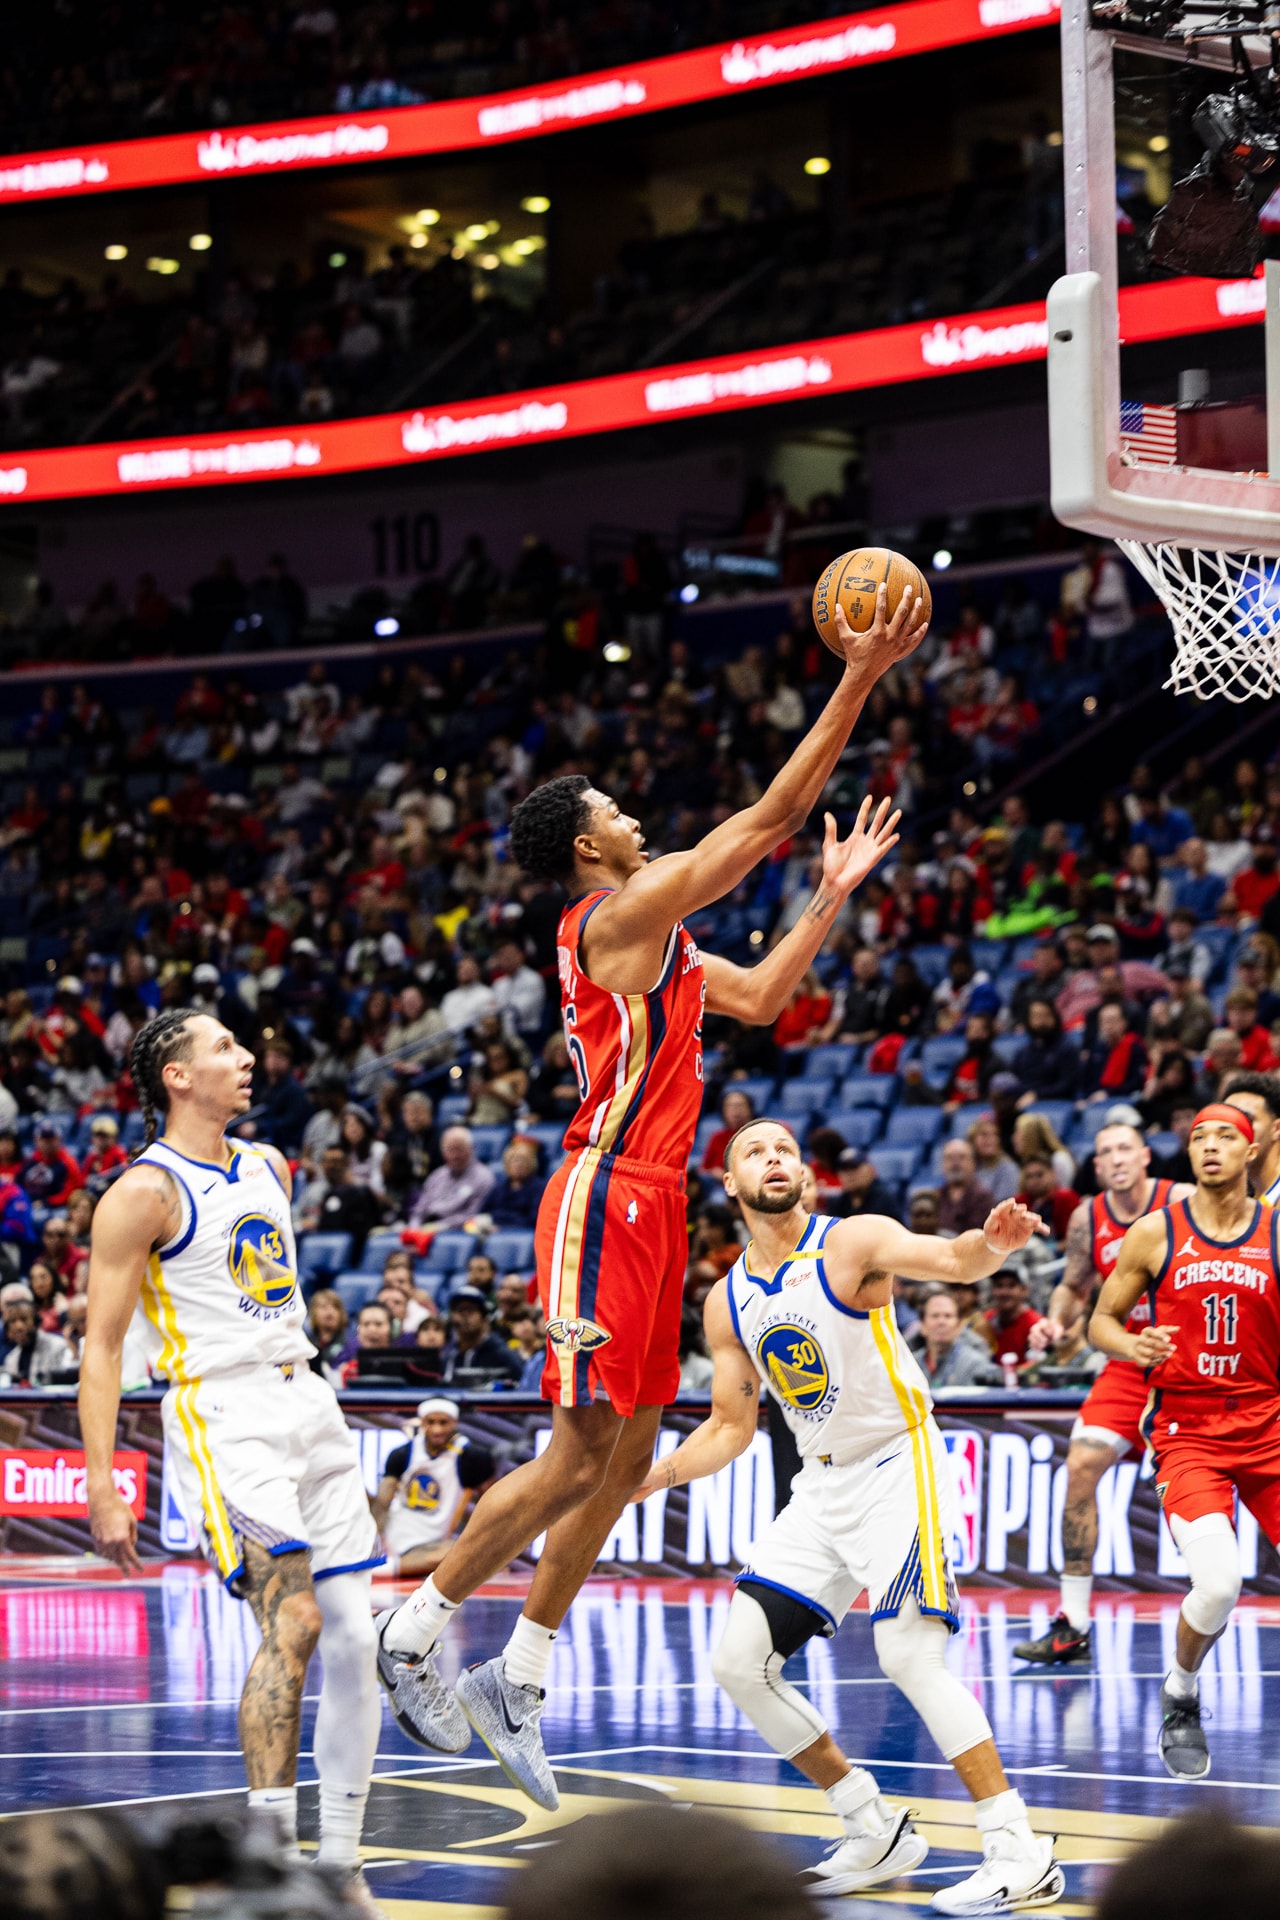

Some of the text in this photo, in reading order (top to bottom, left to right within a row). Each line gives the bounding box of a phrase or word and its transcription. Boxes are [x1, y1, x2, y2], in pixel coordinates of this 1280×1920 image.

[368, 510, 440, 577] 110
[260, 1231, 283, 1260] 43
[1174, 1260, 1269, 1295] CRESCENT
[785, 1312, 818, 1333] STATE
[1202, 1293, 1239, 1345] 11
[786, 1341, 817, 1369] 30
[1197, 1352, 1242, 1376] CITY
[4, 1457, 138, 1504] Emiras
